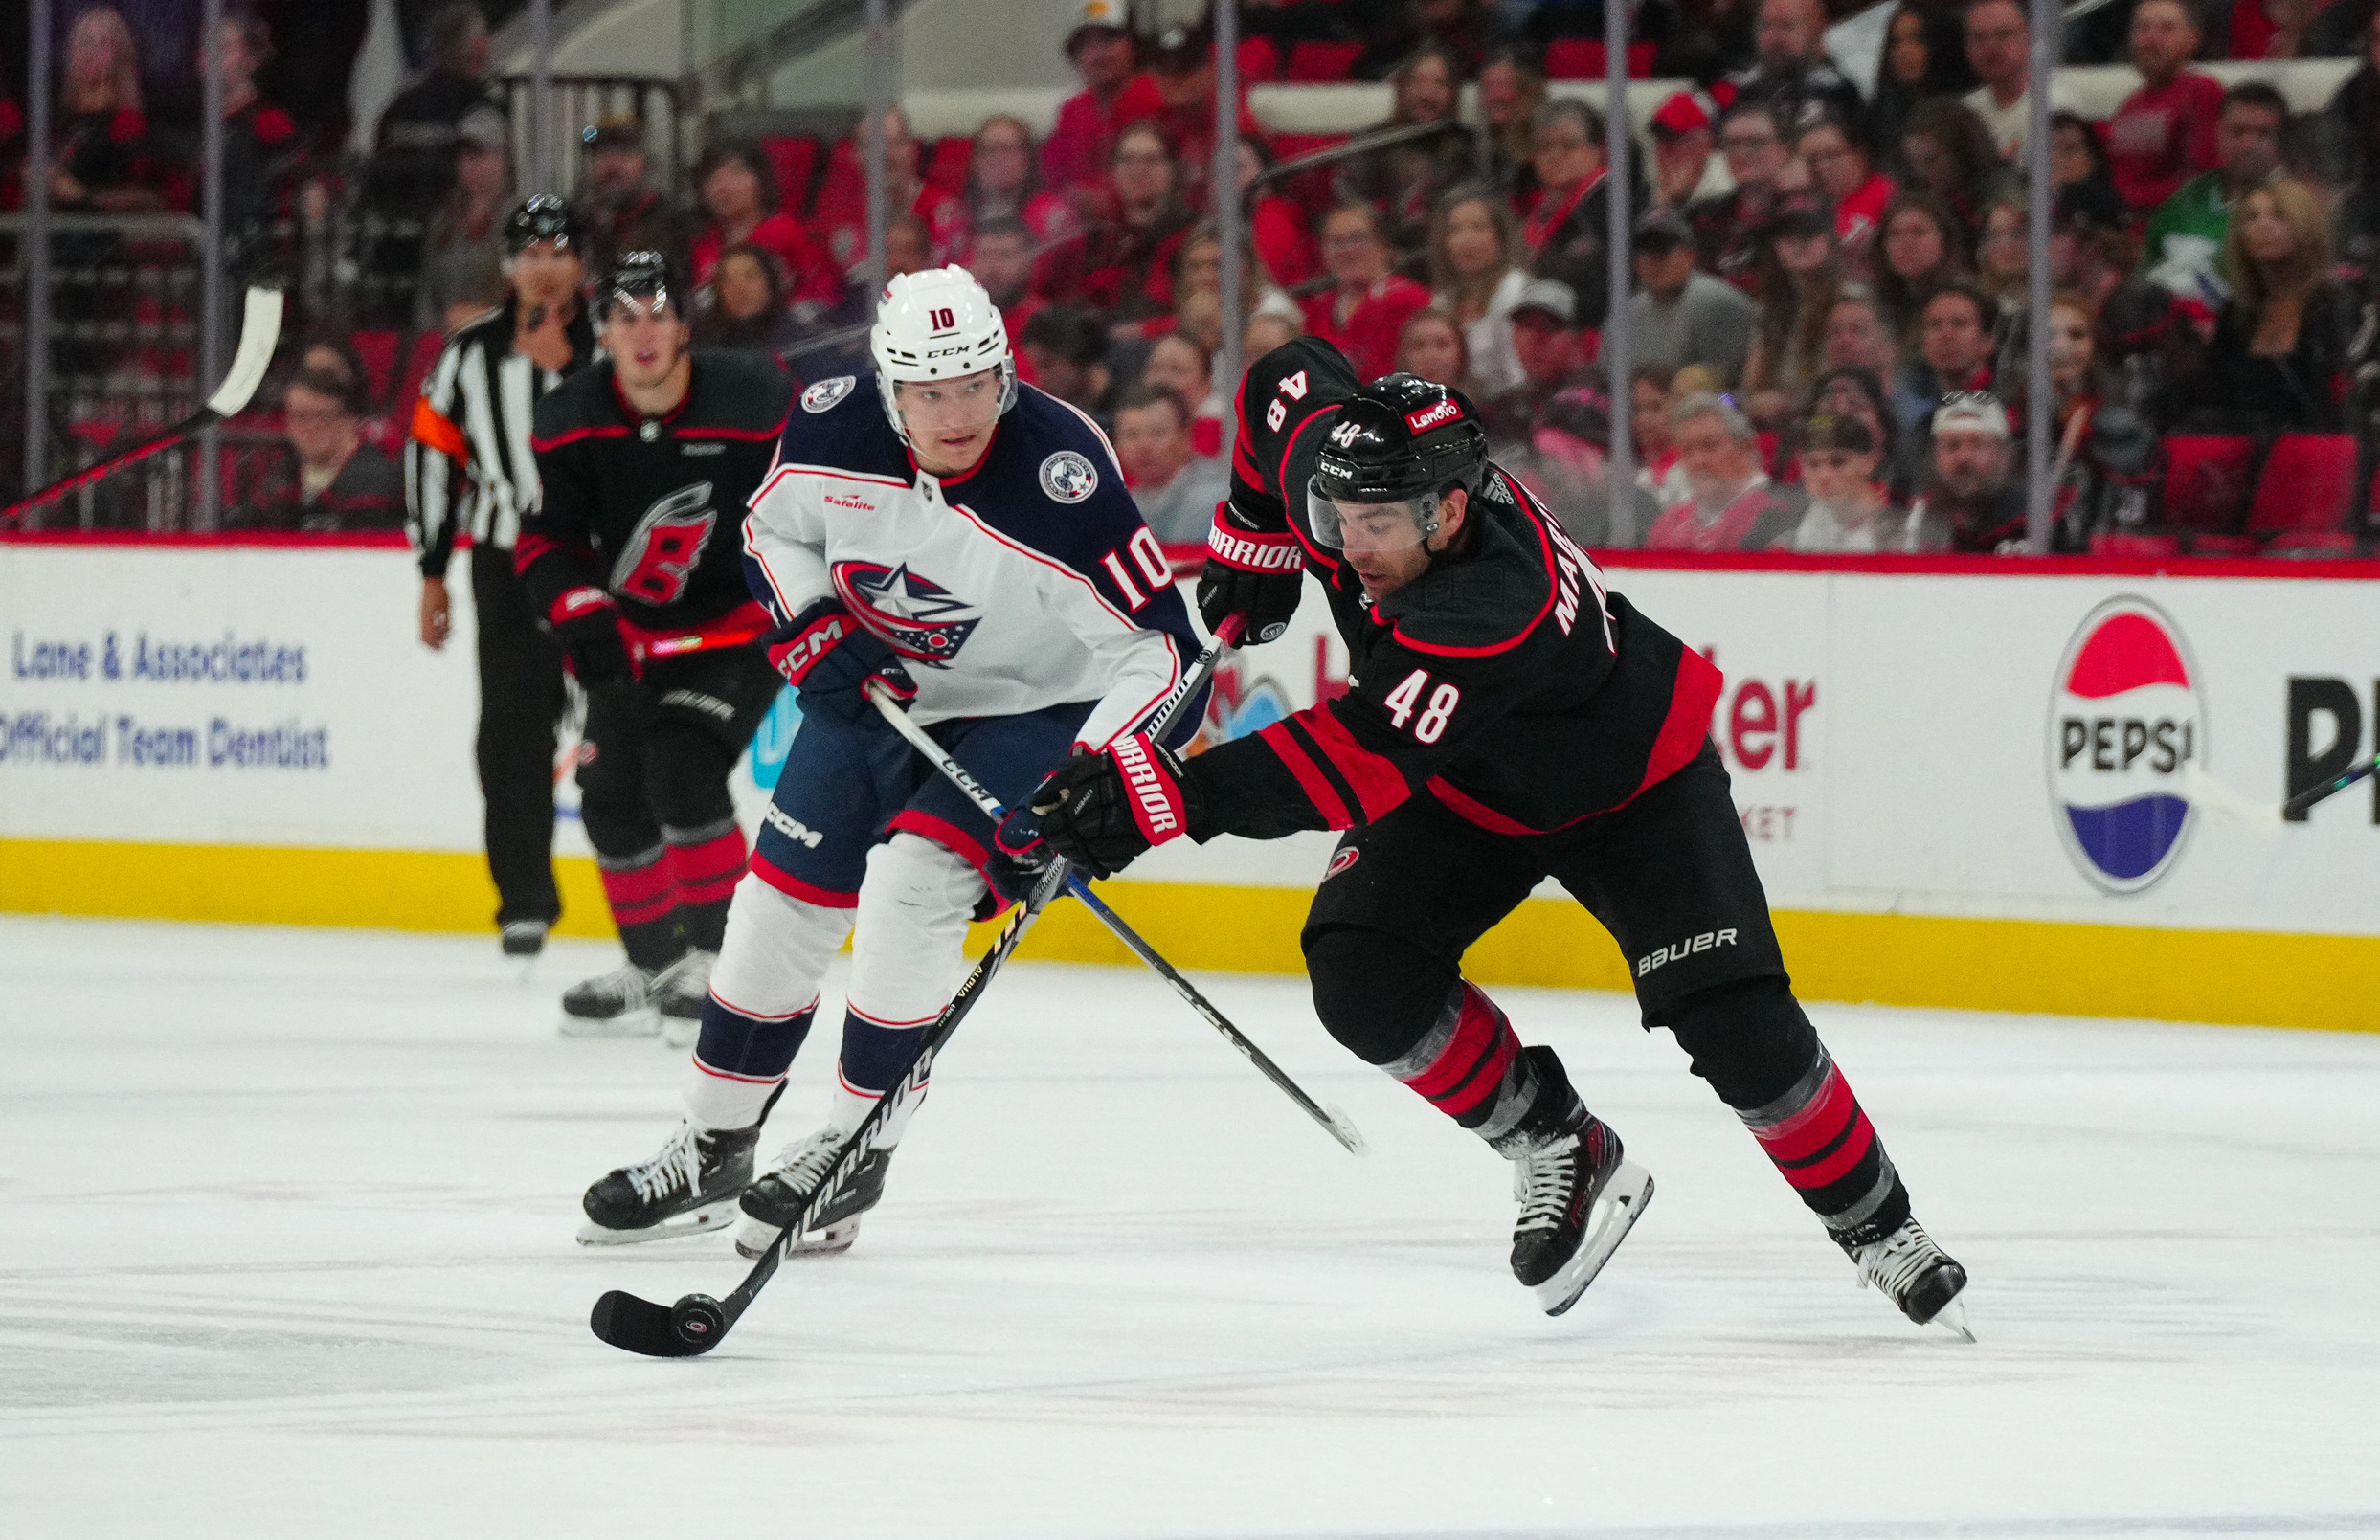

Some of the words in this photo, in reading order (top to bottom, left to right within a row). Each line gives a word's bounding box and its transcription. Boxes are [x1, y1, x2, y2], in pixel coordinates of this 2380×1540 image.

[928, 308, 955, 331] 10
[927, 346, 970, 359] CCM
[1267, 369, 1309, 433] 48
[1410, 404, 1457, 430] Lenovo
[1332, 420, 1361, 448] 48
[1320, 461, 1353, 480] CCM
[1492, 472, 1515, 505] adidas
[824, 495, 876, 512] Safelite
[1098, 524, 1175, 614] 10
[1208, 524, 1303, 569] ARRIOR
[12, 628, 89, 681] Lane
[102, 630, 122, 681] &
[134, 630, 306, 685] Associates
[777, 618, 844, 681] CCM
[1383, 668, 1461, 745] 48
[0, 712, 108, 765] Official
[117, 715, 197, 767] Team
[208, 716, 331, 770] Dentist
[2061, 718, 2194, 772] PEPSI
[2284, 675, 2380, 825] P
[942, 758, 994, 802] CCM
[1111, 734, 1178, 835] ARRIOR
[765, 801, 824, 849] CCM
[1740, 806, 1794, 841] KET
[1637, 927, 1738, 978] BAUER
[777, 1045, 933, 1267] WARRIOR
